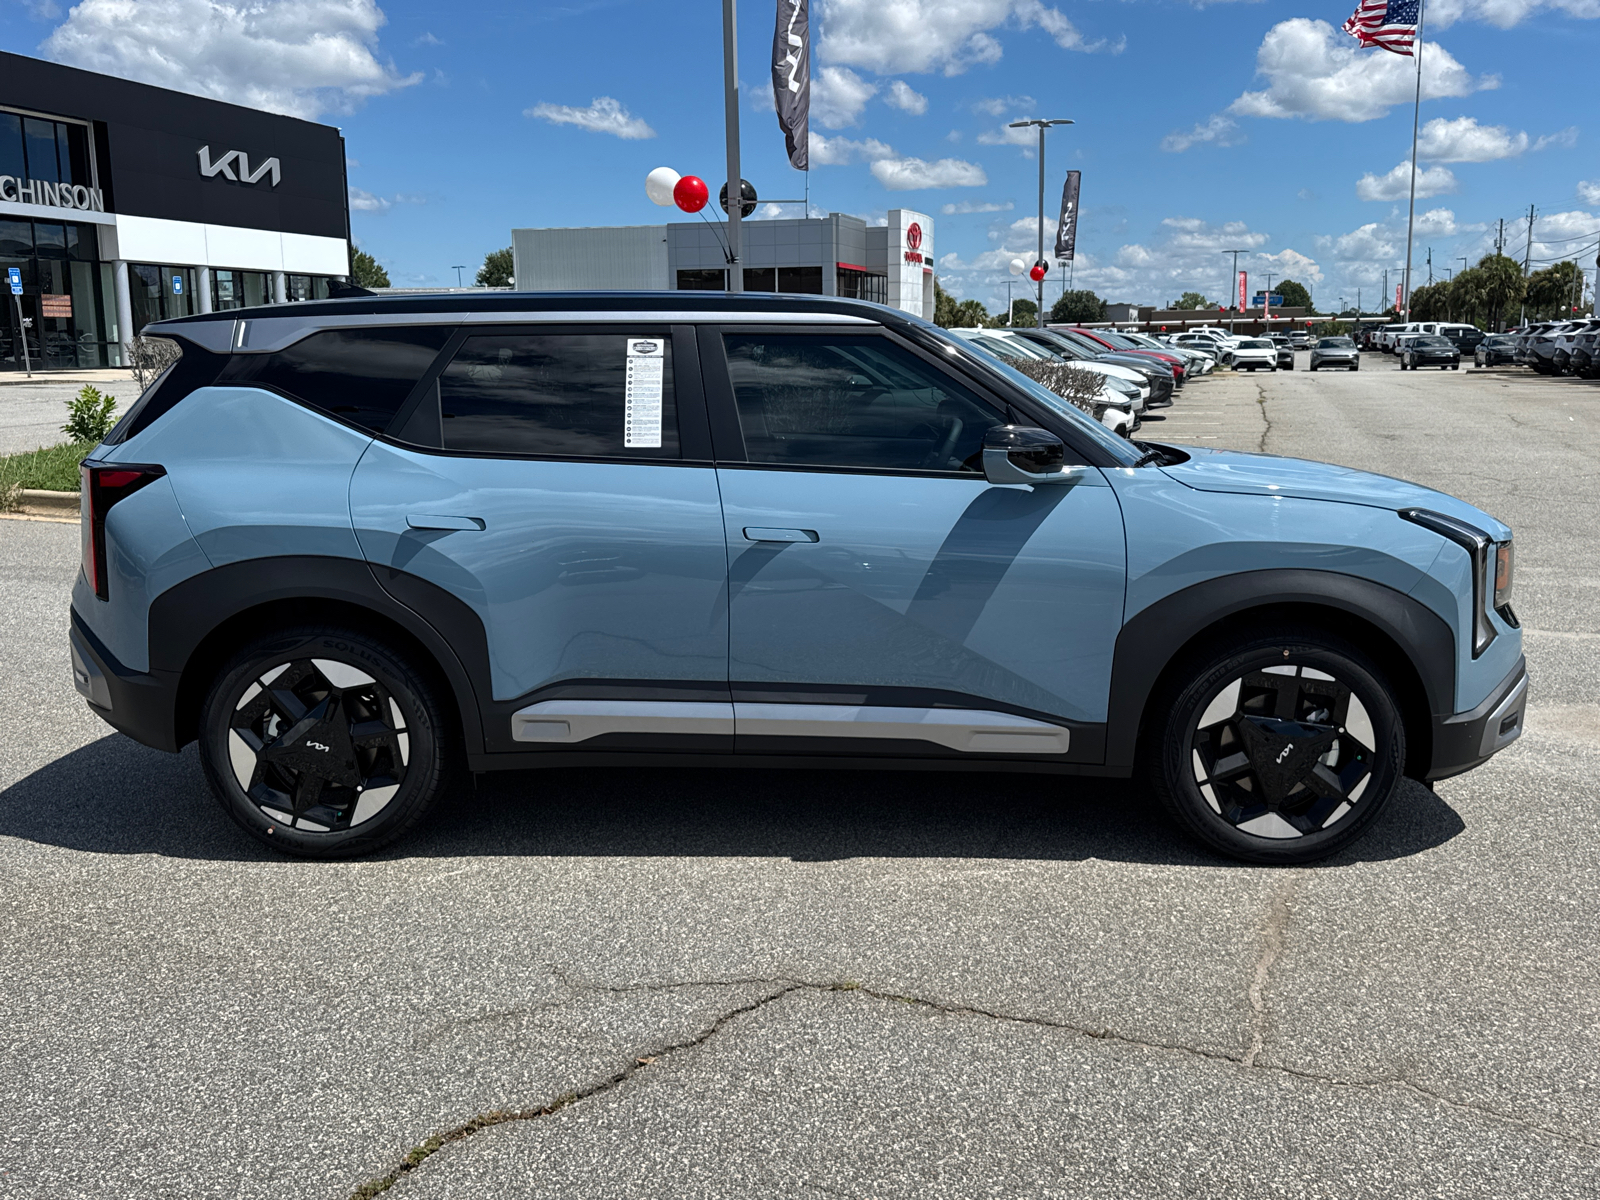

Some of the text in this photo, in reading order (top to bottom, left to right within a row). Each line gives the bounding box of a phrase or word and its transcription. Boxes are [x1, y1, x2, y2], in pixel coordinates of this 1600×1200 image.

[197, 144, 282, 188] KIA
[0, 175, 105, 213] CHINSON
[322, 640, 382, 667] SOLUS
